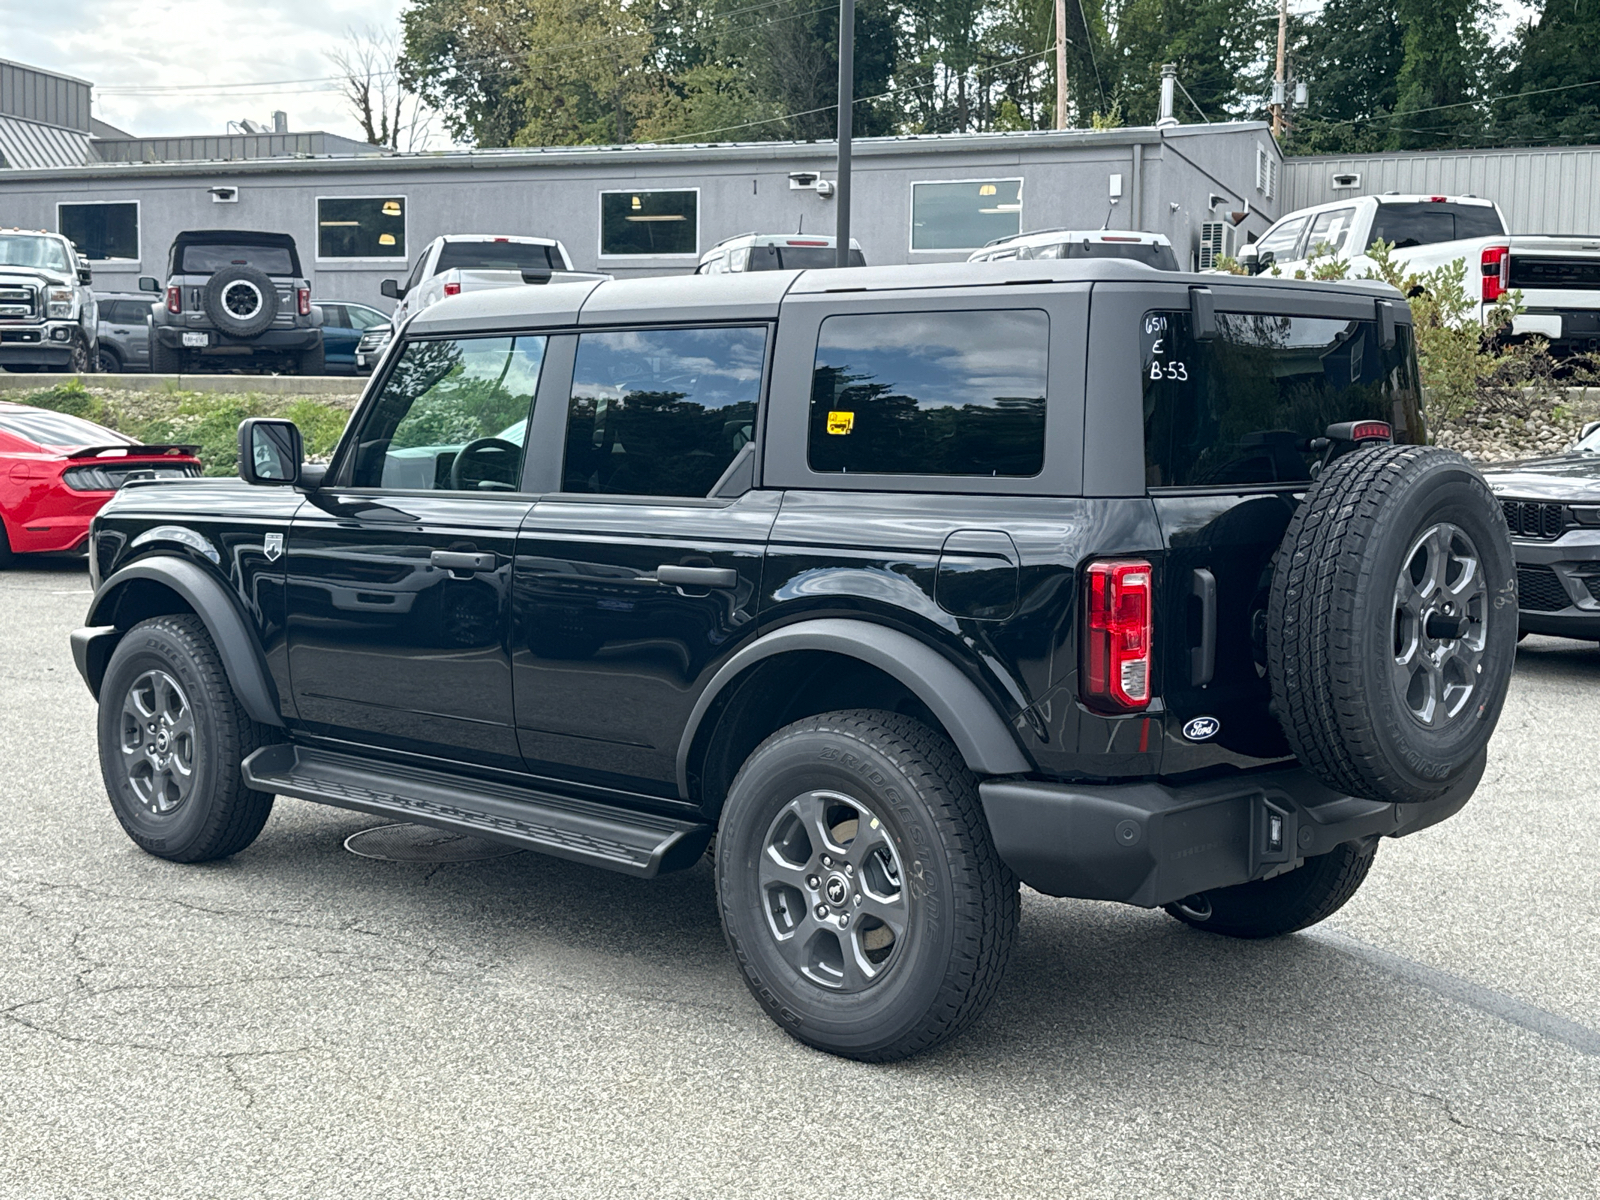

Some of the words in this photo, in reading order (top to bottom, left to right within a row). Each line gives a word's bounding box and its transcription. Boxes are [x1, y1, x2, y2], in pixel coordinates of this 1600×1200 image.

[1145, 316, 1168, 334] 6511
[1152, 339, 1164, 354] E
[1150, 361, 1188, 381] B-53
[1191, 720, 1214, 736] Ford
[817, 747, 941, 943] BRIDGESTONE
